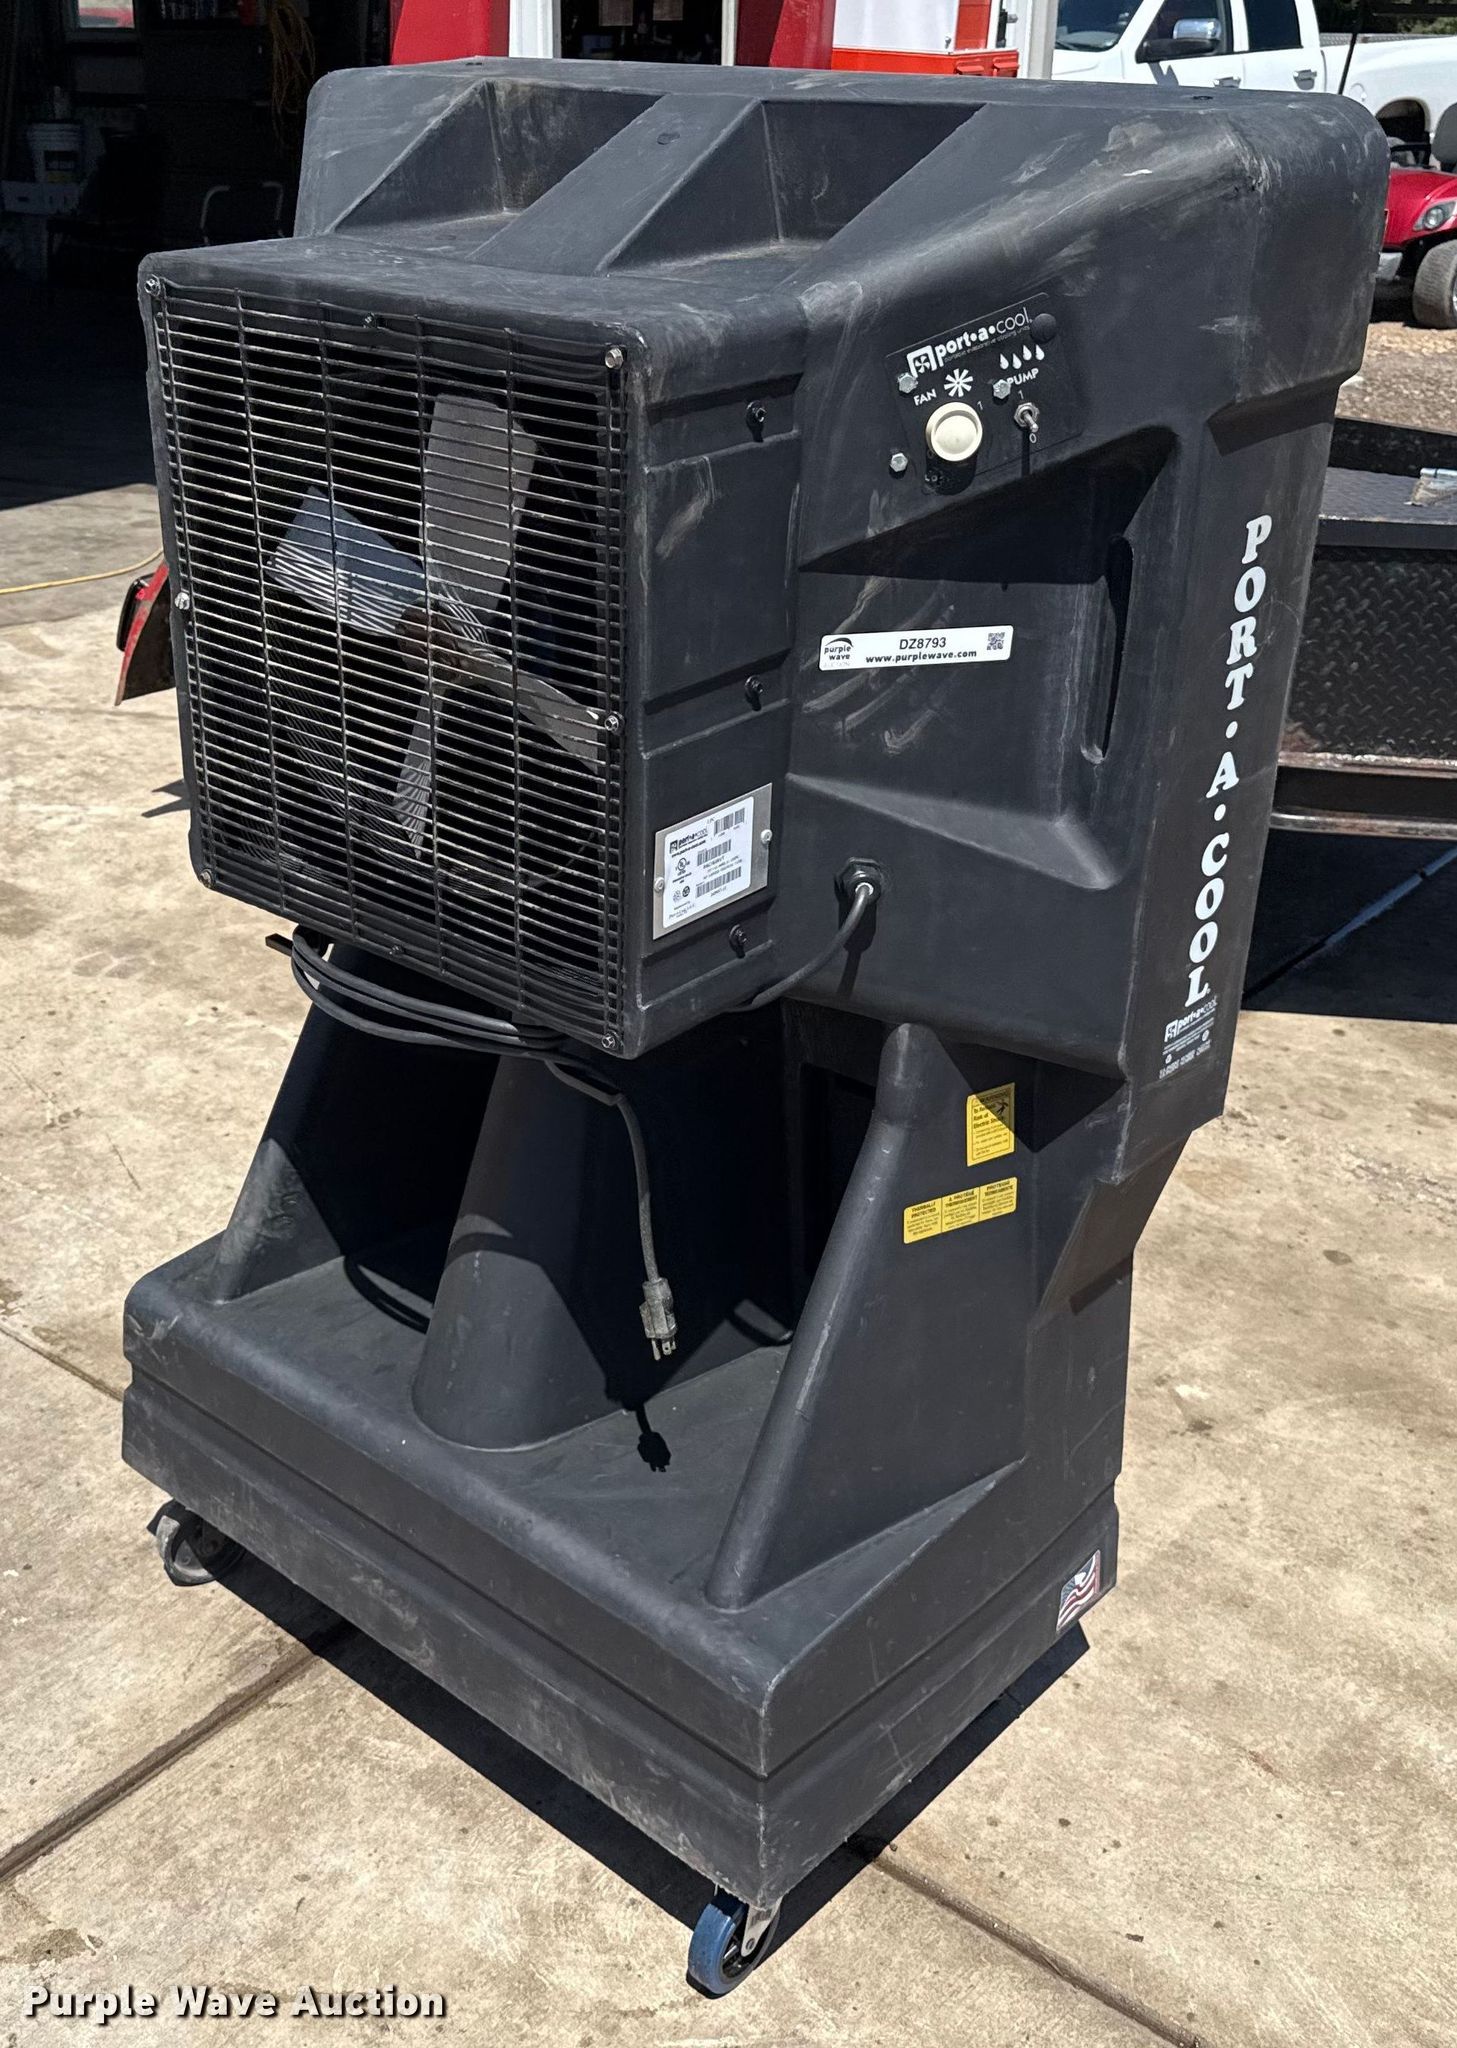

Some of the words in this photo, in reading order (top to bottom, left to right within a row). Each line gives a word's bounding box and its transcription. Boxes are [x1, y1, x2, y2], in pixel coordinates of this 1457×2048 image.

[1007, 368, 1039, 386] PUMP
[913, 389, 937, 406] FAN
[824, 644, 852, 654] purple
[899, 637, 947, 650] DZ8793
[829, 653, 850, 661] wave
[865, 649, 977, 664] www.purplewave.com
